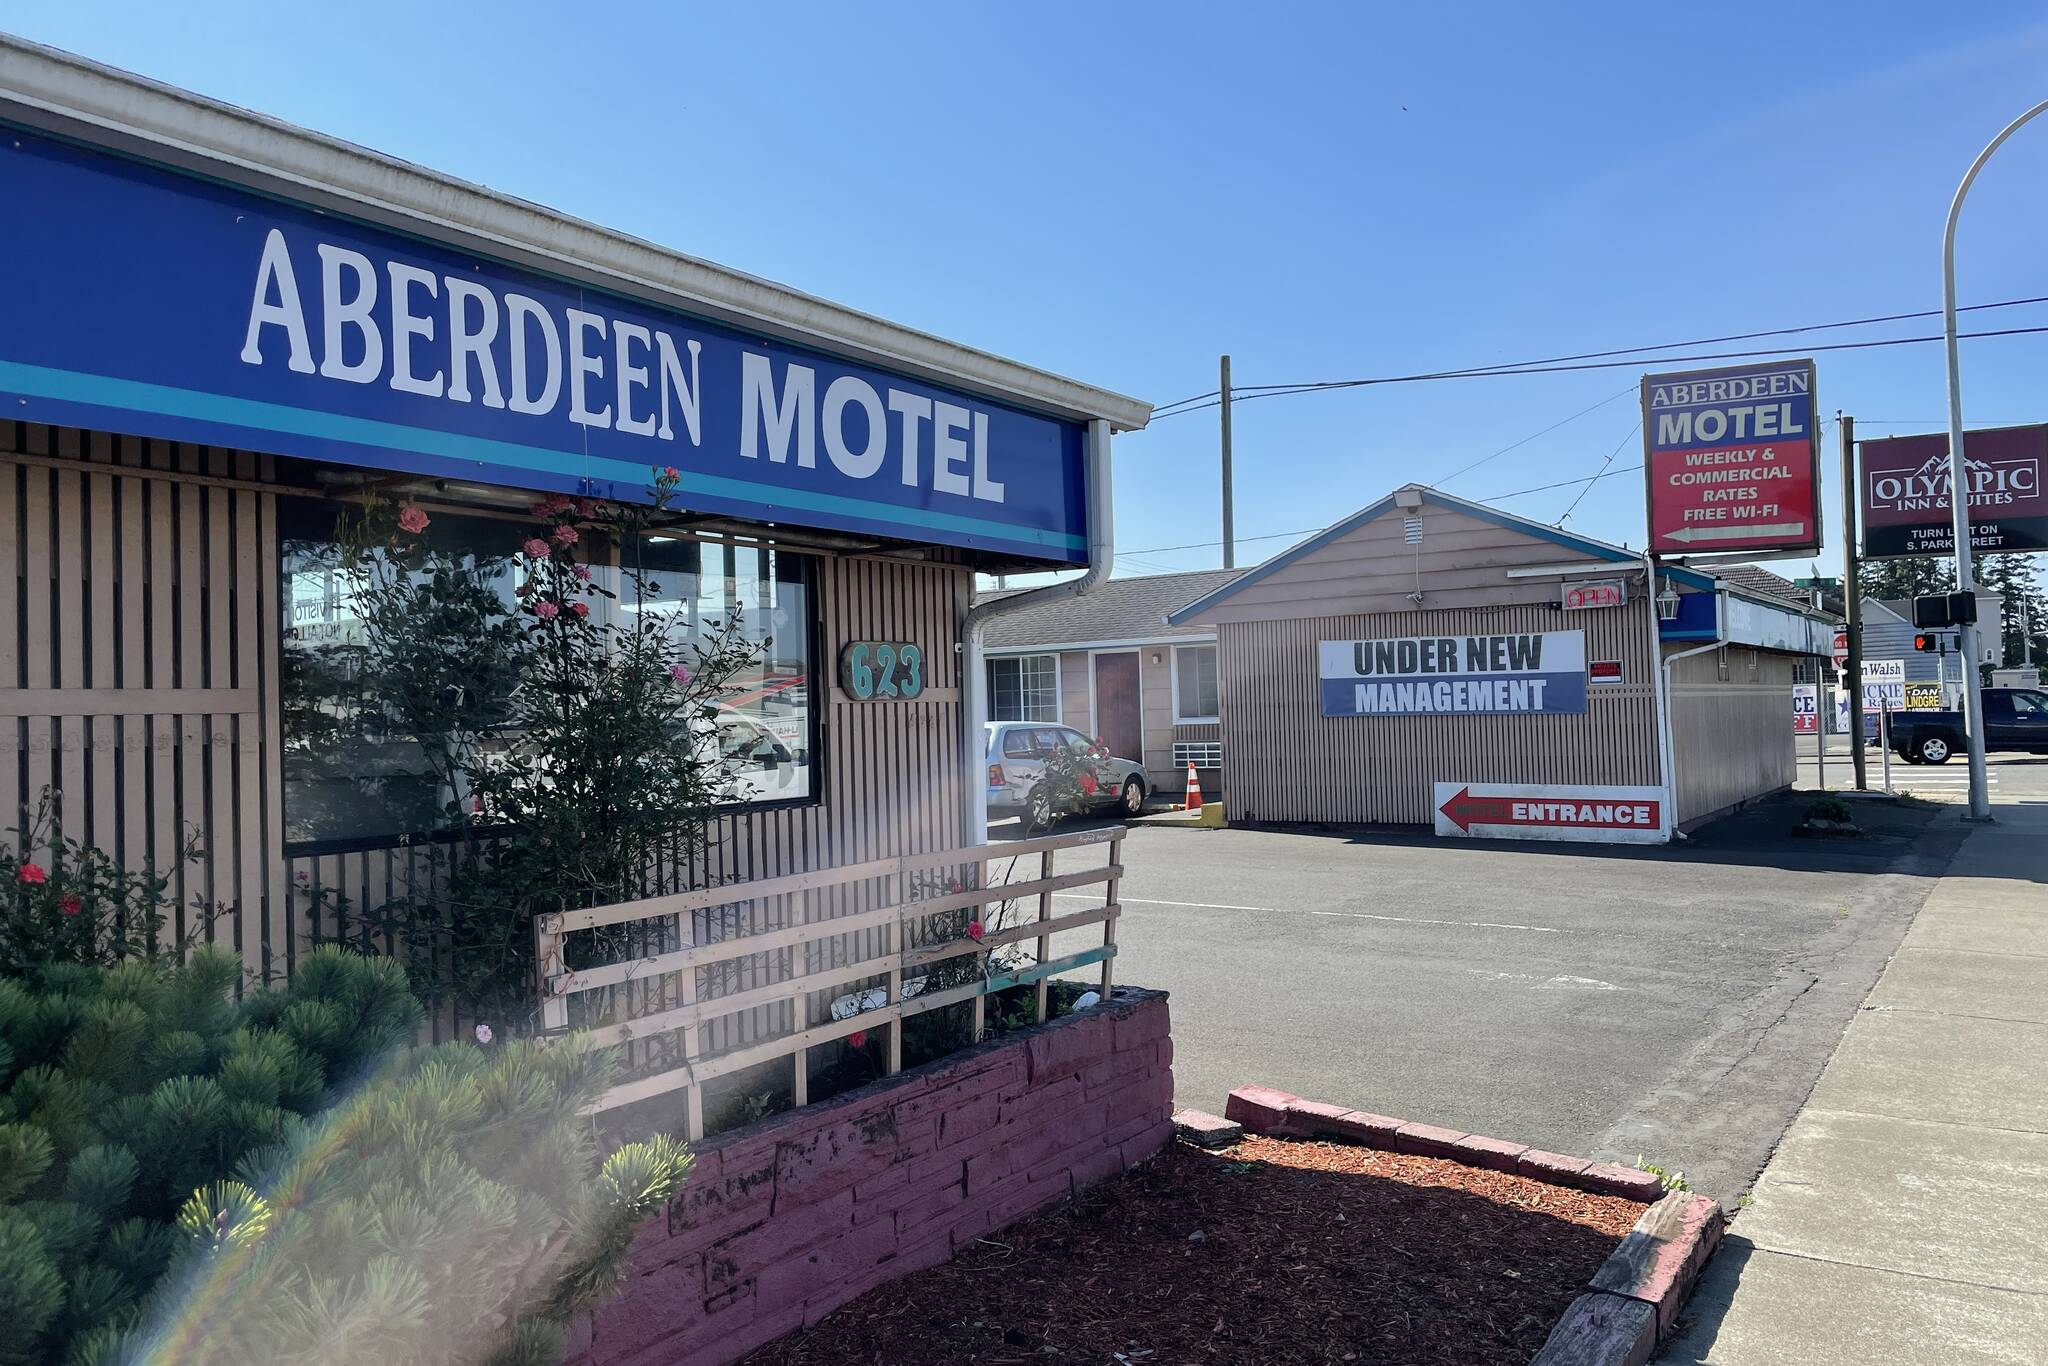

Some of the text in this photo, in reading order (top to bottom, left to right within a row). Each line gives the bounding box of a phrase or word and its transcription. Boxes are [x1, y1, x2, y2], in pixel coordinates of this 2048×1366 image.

[240, 228, 1005, 504] ABERDEEN MOTEL
[1651, 372, 1809, 407] ABERDEEN
[1657, 402, 1803, 446] MOTEL
[1685, 447, 1775, 466] WEEKLY &
[1669, 465, 1793, 486] COMMERCIAL
[1875, 467, 2034, 499] OLYMPIC
[1703, 486, 1758, 502] RATES
[1897, 491, 2013, 511] INN & UITES
[1683, 504, 1779, 521] FREE WI-FI
[1911, 524, 1998, 540] TURN LT ON
[1906, 536, 2004, 550] S. PARK REET
[1567, 585, 1621, 608] OPEN
[1354, 634, 1543, 676] UNDER NEW
[852, 644, 921, 698] 623
[1869, 663, 1901, 675] Walsh
[1354, 679, 1547, 713] MANAGEMENT
[1862, 684, 1903, 699] ICKIE
[1906, 695, 1940, 708] LINDGRE
[1911, 688, 1938, 696] DAN
[1512, 802, 1651, 826] ENTRANCE
